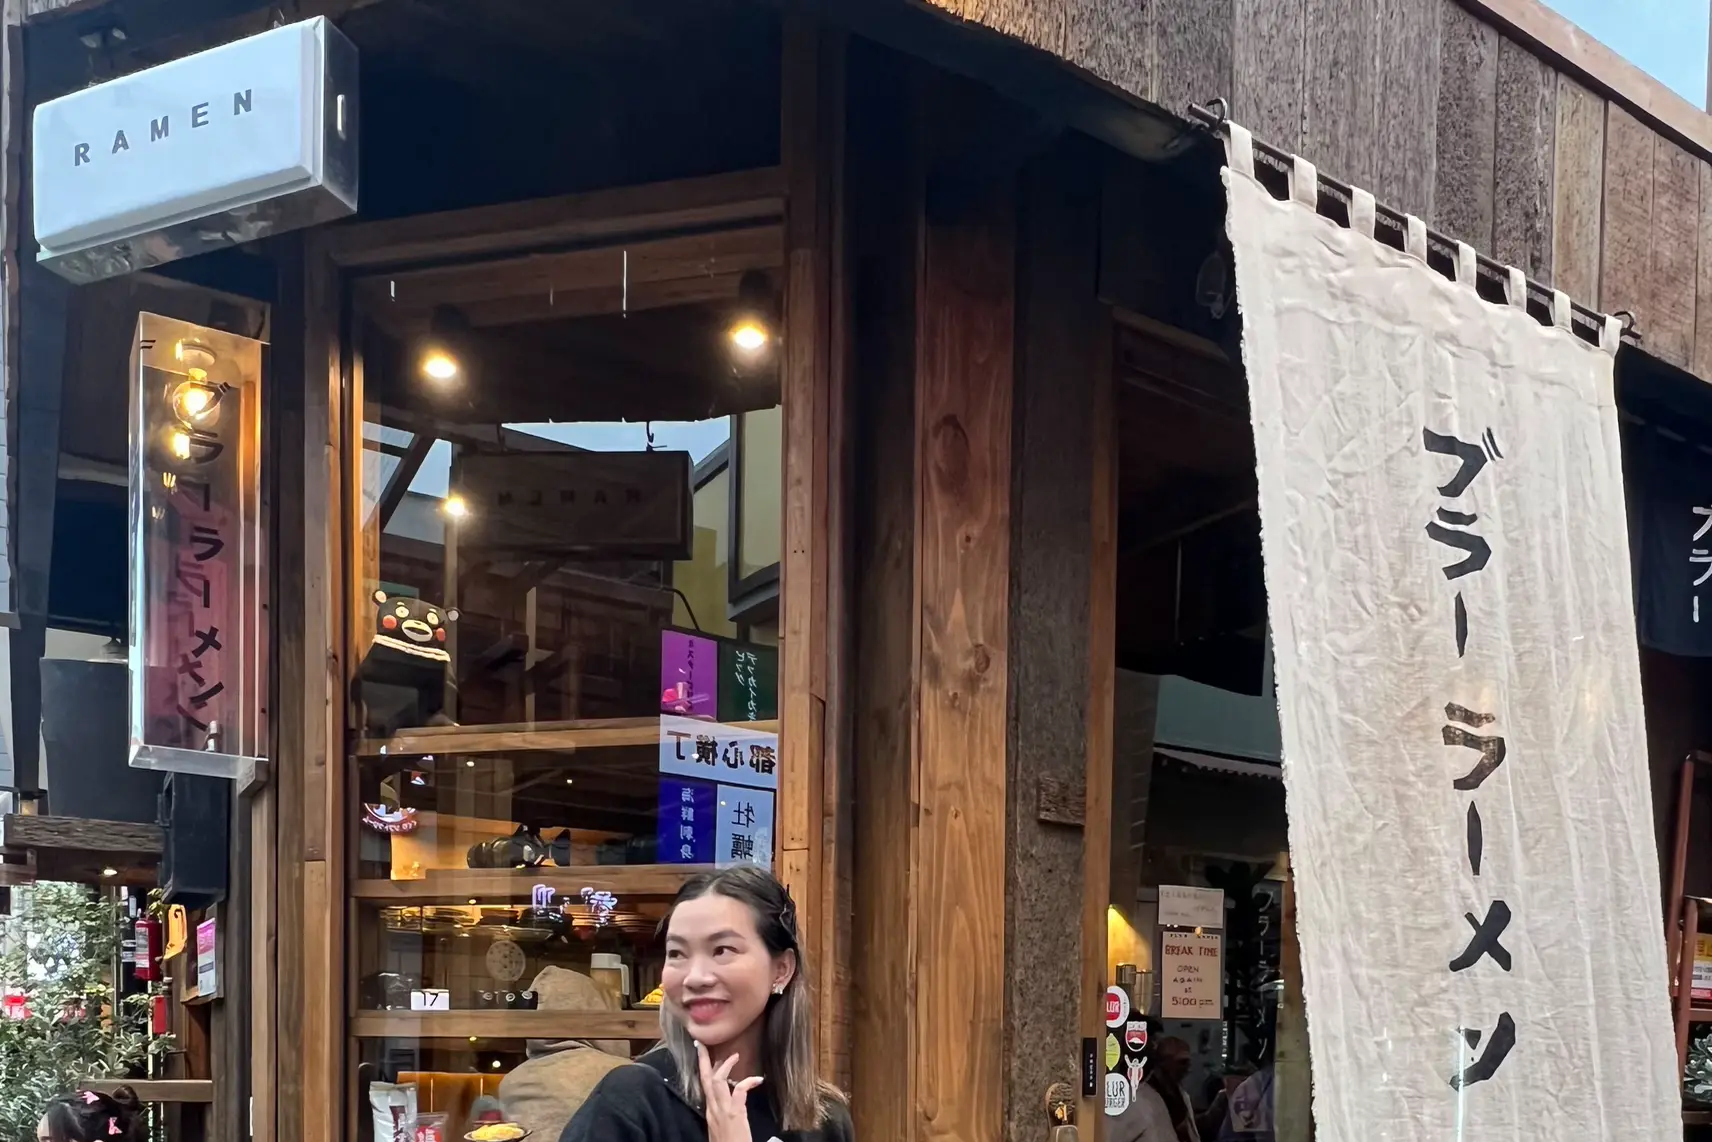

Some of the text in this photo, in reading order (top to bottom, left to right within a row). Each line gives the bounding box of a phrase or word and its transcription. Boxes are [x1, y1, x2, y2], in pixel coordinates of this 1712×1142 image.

[74, 89, 253, 166] RAMEN
[1165, 944, 1218, 957] BREAK TIME
[1177, 965, 1200, 973] OPEN
[1106, 1081, 1126, 1097] LUR
